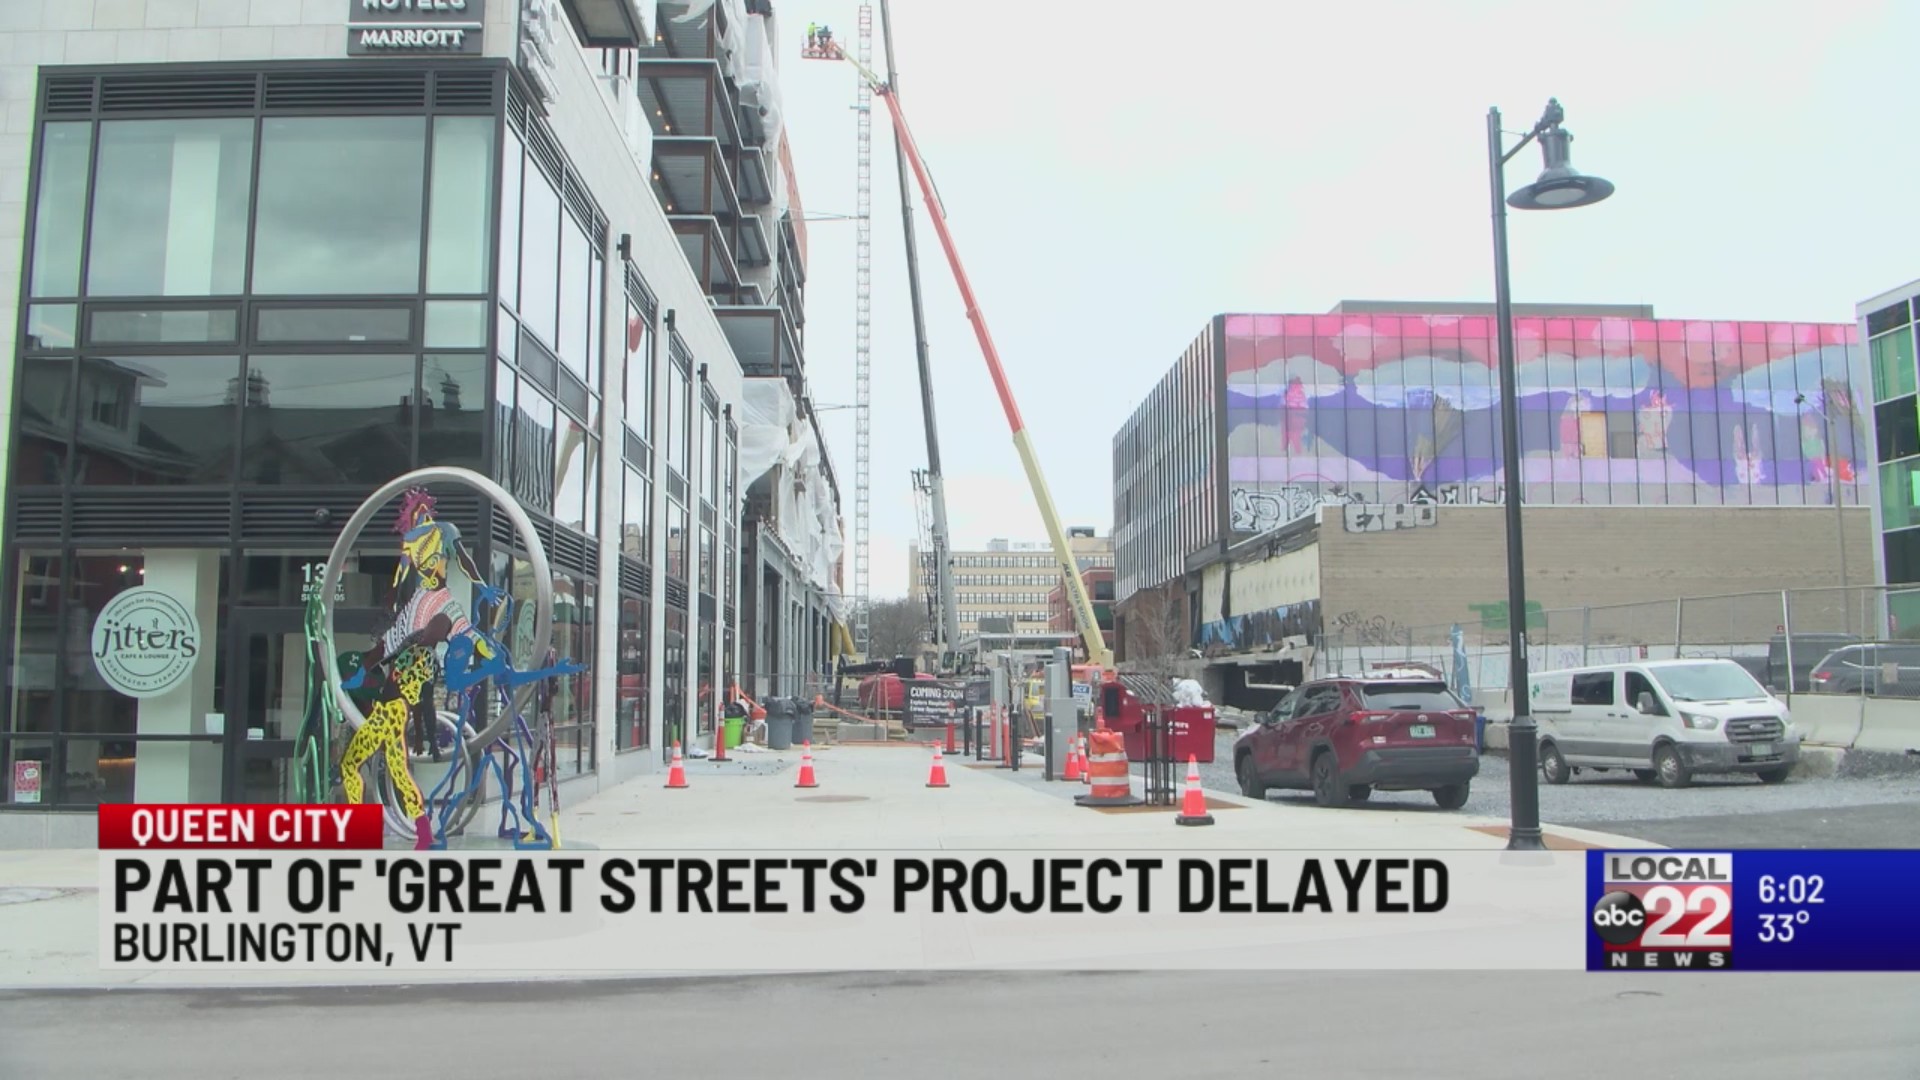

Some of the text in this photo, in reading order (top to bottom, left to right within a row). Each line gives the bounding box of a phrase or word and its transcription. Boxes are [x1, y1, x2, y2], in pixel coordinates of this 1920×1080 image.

[361, 29, 464, 48] MARRIOTT
[95, 619, 196, 659] jitters
[910, 687, 941, 698] COMING
